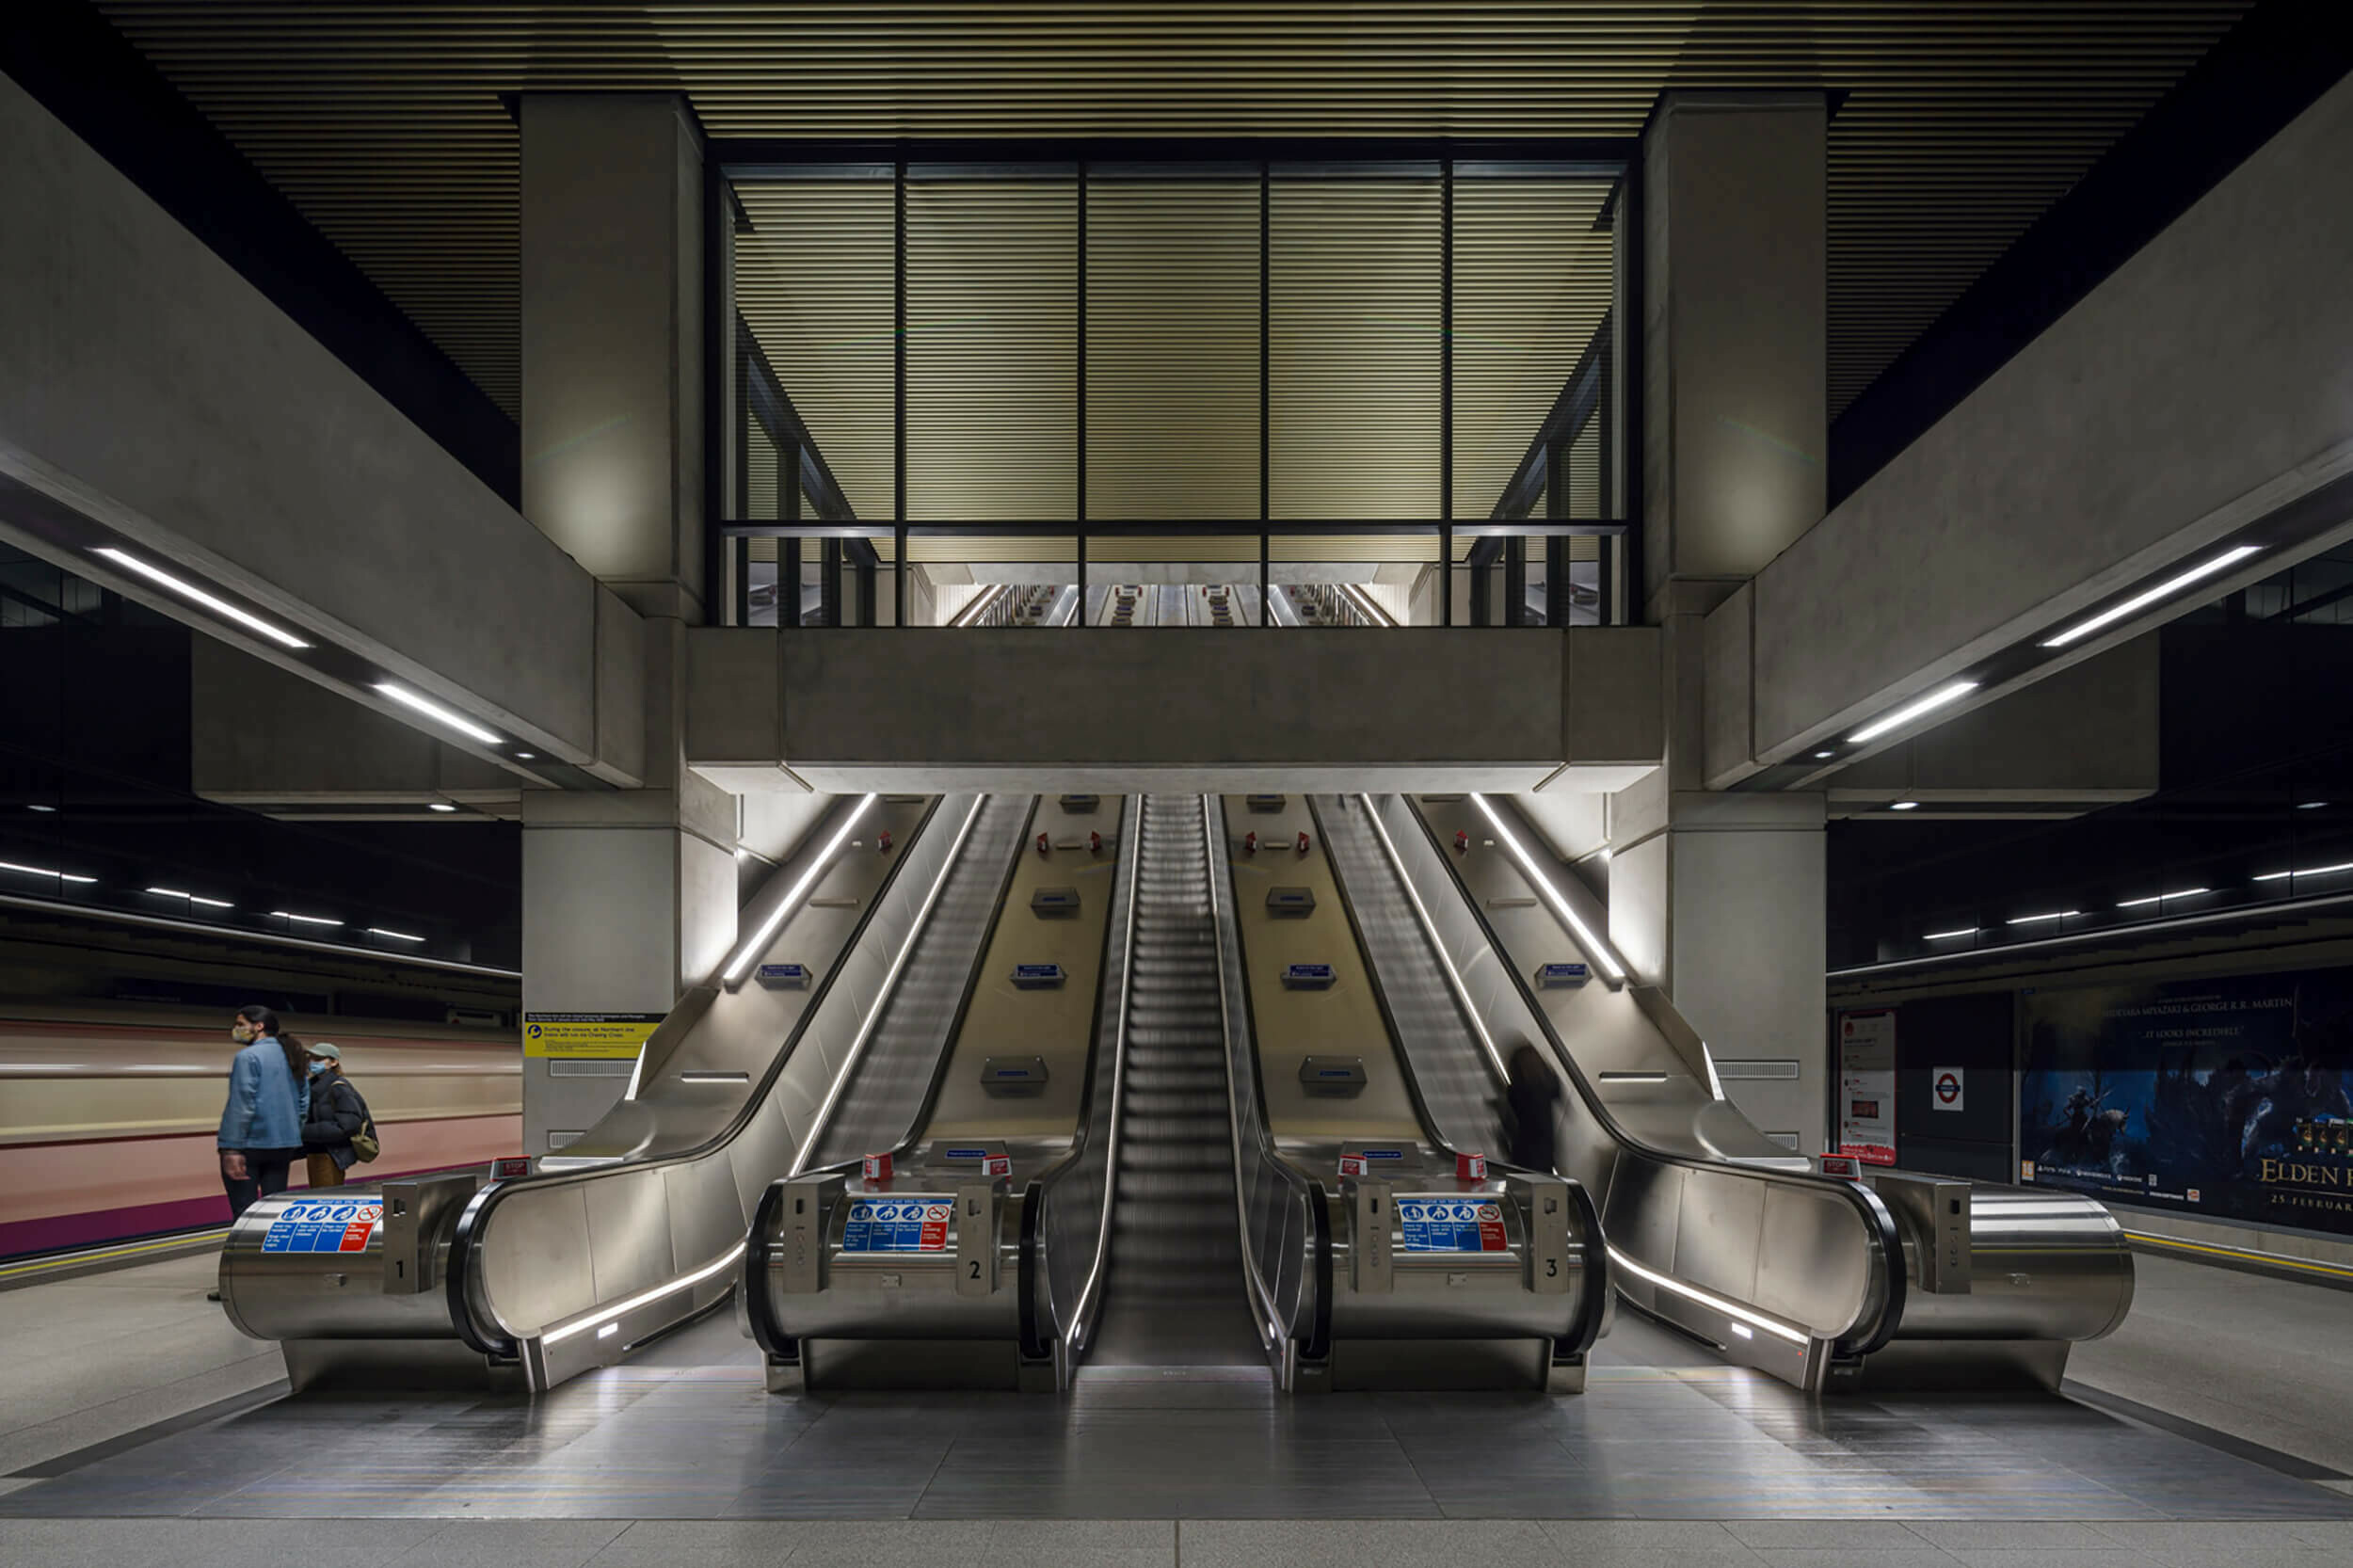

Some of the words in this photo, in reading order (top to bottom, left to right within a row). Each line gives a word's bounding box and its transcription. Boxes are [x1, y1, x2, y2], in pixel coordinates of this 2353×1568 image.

[2253, 998, 2293, 1009] MARTIN
[2260, 1159, 2339, 1186] ELDEN
[2271, 1194, 2285, 1205] 25
[396, 1260, 403, 1279] 1
[969, 1260, 981, 1279] 2
[1546, 1259, 1558, 1277] 3
